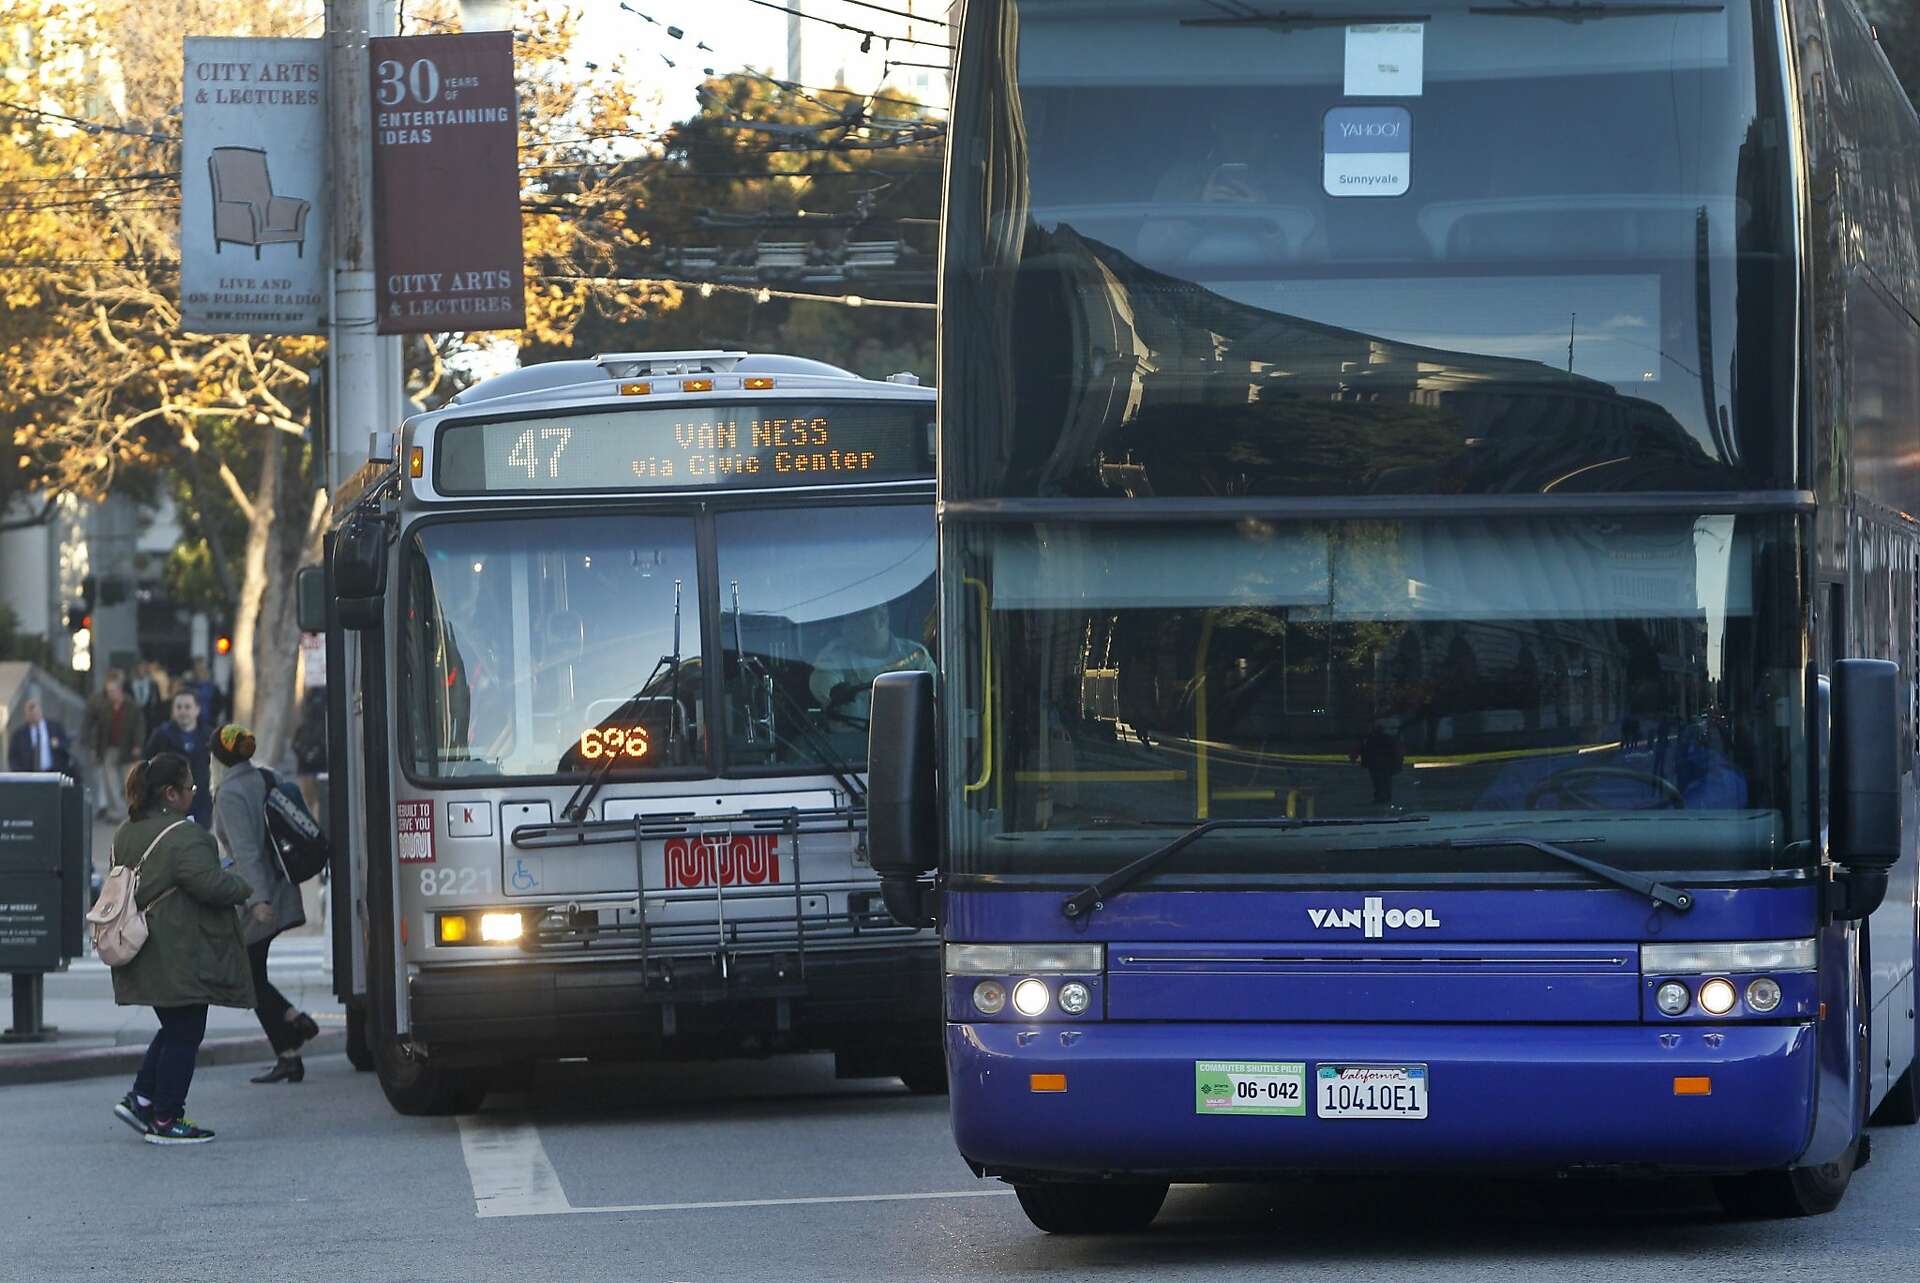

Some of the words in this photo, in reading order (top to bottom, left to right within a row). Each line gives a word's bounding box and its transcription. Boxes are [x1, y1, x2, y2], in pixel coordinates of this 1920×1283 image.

[196, 62, 252, 81] CITY
[259, 63, 320, 82] ARTS
[377, 58, 439, 105] 30
[444, 76, 480, 88] YEARS
[195, 87, 208, 104] &
[216, 88, 320, 105] LECTURES
[444, 90, 458, 101] OF
[378, 107, 508, 127] ENTERTAINING
[379, 128, 432, 145] IDEAS
[1340, 122, 1400, 137] YAHOO!
[1339, 174, 1399, 186] Sunnyvale
[218, 278, 257, 289] LIVE
[262, 278, 293, 289] AND
[388, 273, 443, 295] CITY
[450, 269, 513, 292] ARTS
[214, 293, 269, 305] PUBLIC
[274, 293, 321, 305] RADIO
[389, 300, 402, 317] &
[407, 296, 513, 316] LECTURES
[673, 421, 737, 451] VAN
[751, 417, 829, 447] NESS
[507, 426, 572, 480] 47
[631, 453, 674, 478] via
[688, 451, 760, 476] Civic
[775, 448, 876, 474] Center
[580, 726, 648, 759] 696
[420, 803, 430, 817] TO
[463, 807, 474, 824] K
[414, 817, 430, 830] YOU
[420, 867, 494, 897] 8221
[1200, 1063, 1245, 1073] COMMUTER
[1247, 1064, 1280, 1073] SHUTTLE
[1281, 1065, 1303, 1074] PILOT
[1340, 1067, 1401, 1083] California
[1237, 1081, 1299, 1099] 06-042
[1325, 1085, 1420, 1111] 10410E1
